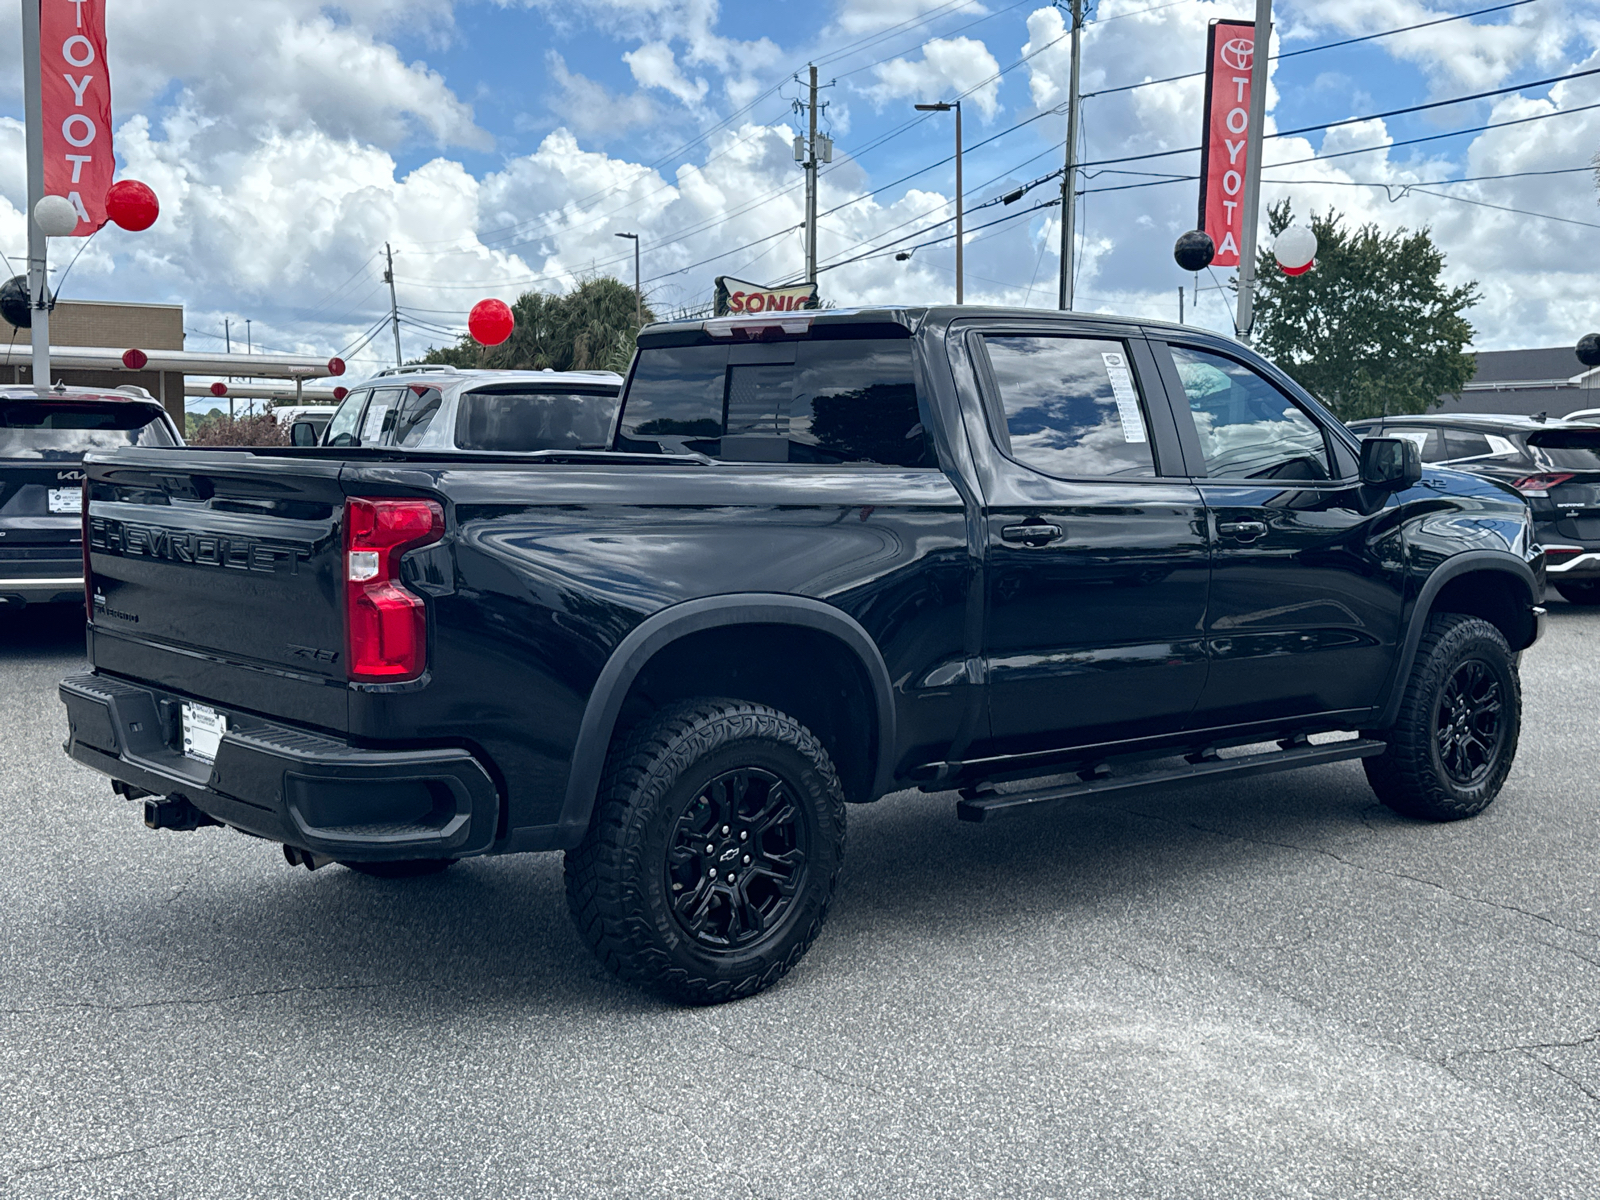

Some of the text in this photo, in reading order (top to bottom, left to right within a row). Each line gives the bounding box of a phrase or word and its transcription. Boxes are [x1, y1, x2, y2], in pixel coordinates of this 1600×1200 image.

[62, 0, 97, 223] TOYOTA
[1218, 77, 1249, 256] TOYOTA
[90, 518, 310, 576] CHEVROLET
